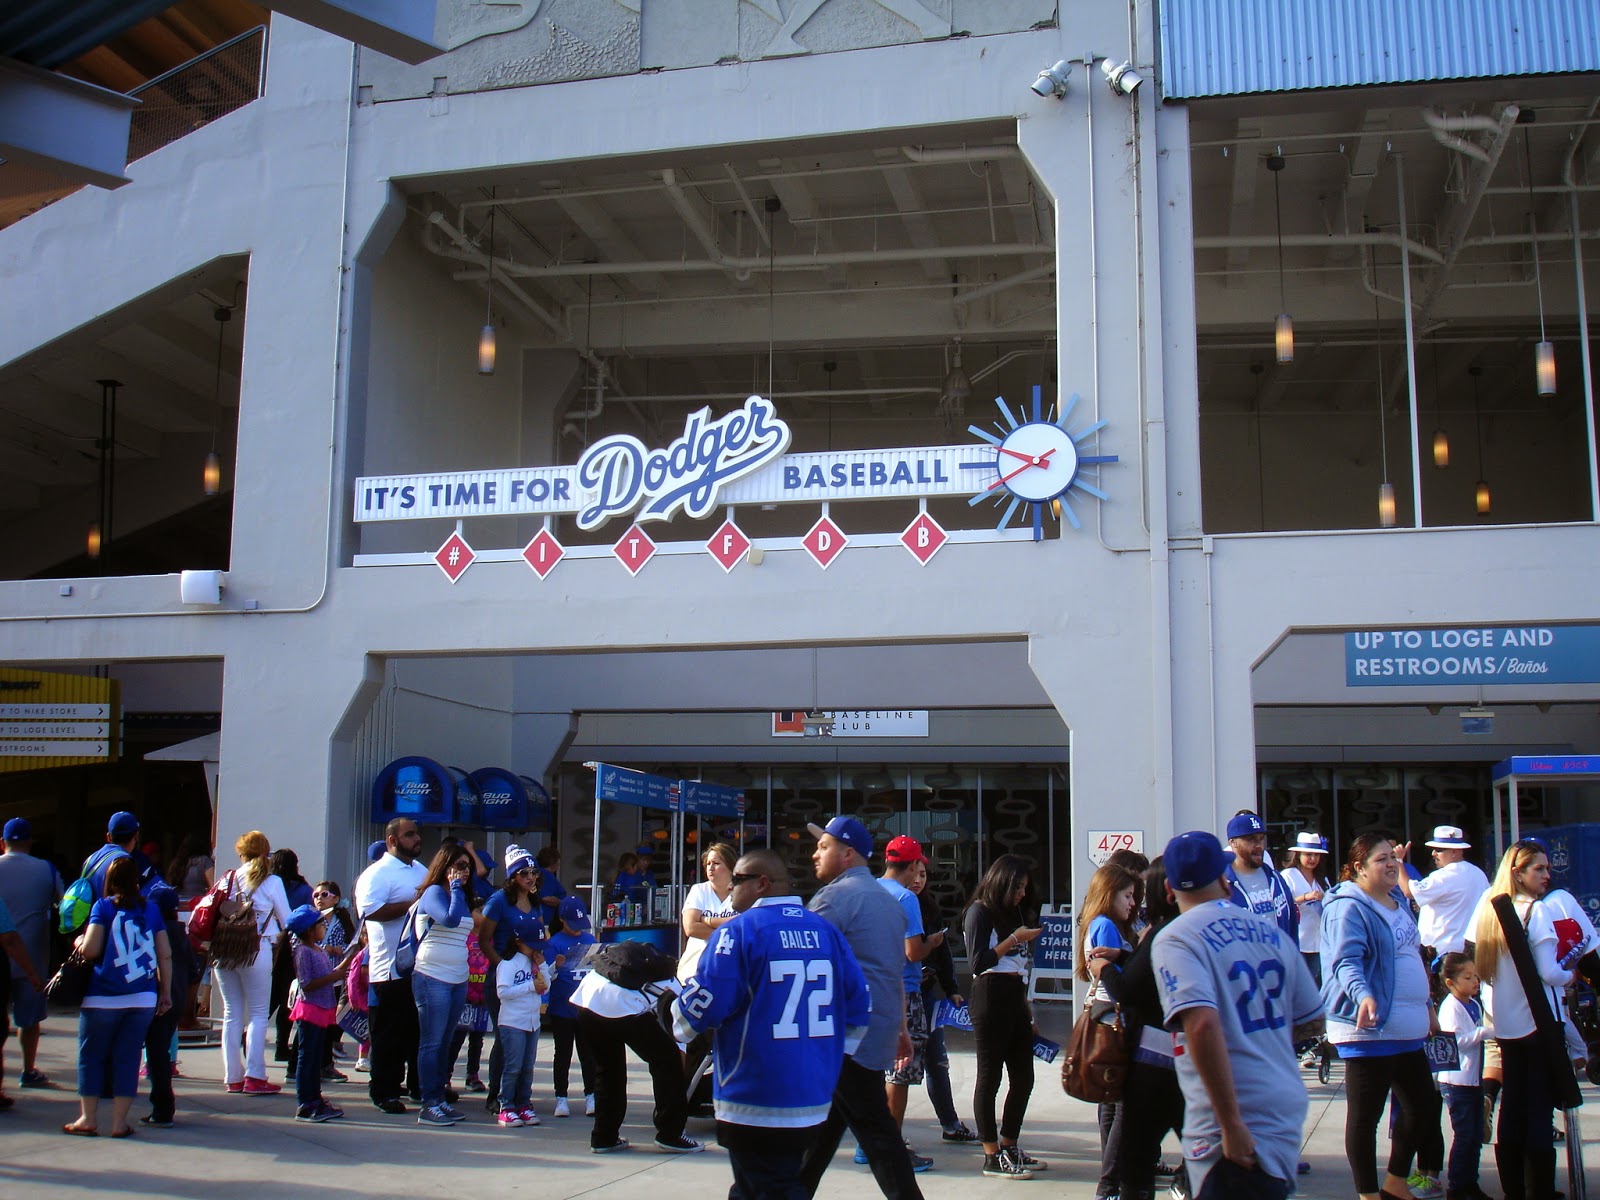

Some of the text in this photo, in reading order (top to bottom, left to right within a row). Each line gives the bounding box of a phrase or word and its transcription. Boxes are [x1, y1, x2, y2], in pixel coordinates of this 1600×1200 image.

[364, 399, 949, 529] IT'S TIME FOR Dodger BASEBALL
[817, 532, 832, 552] D
[916, 526, 930, 549] B
[1354, 628, 1553, 649] UP TO LOGE AND
[9, 707, 20, 715] TO
[24, 707, 46, 715] NIKE
[50, 707, 77, 715] STORE
[831, 711, 914, 719] BASELINE
[24, 726, 47, 734] LOGE
[50, 726, 76, 734] LEVEL
[831, 722, 871, 730] CLUB
[406, 781, 430, 789] BUD
[1097, 834, 1134, 851] 479
[1047, 923, 1072, 933] TOU
[1198, 917, 1282, 953] KERSHAW
[779, 929, 821, 949] BAILEY
[1044, 950, 1073, 960] HERE
[681, 978, 714, 1019] 72
[769, 959, 835, 1040] 72
[1226, 958, 1286, 1034] 22
